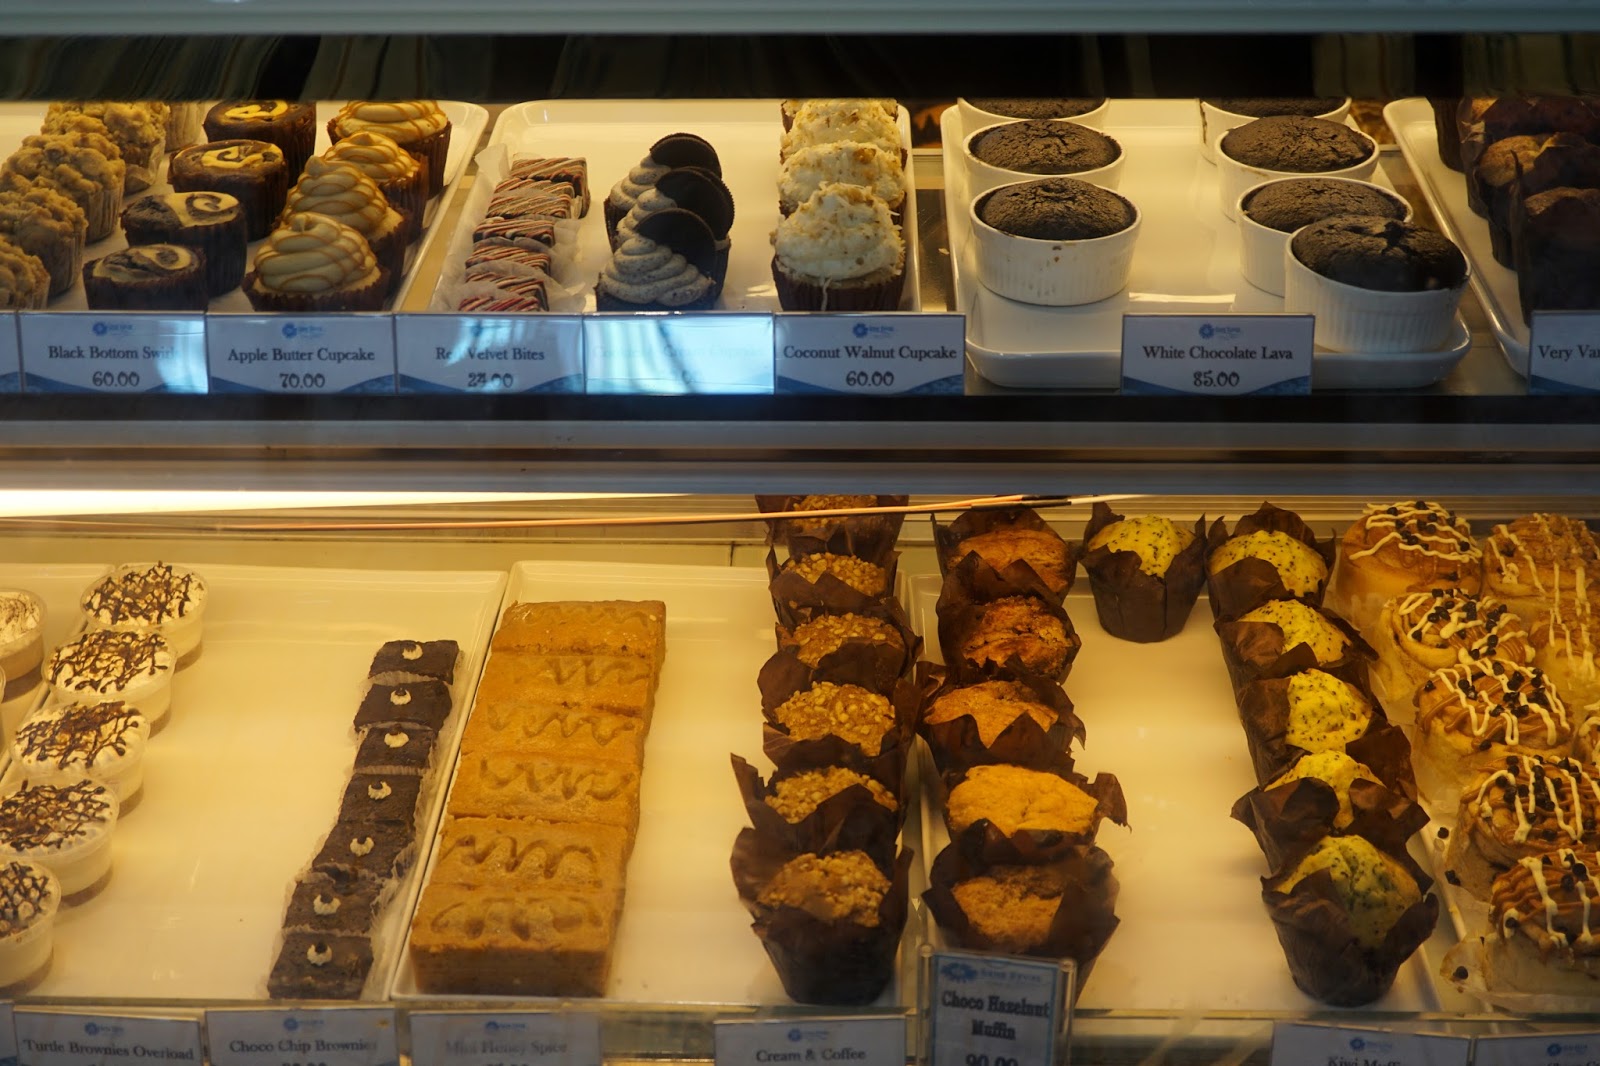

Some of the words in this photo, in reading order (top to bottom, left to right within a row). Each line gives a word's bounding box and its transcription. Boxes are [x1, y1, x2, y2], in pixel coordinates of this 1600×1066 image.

[48, 345, 85, 359] Black
[89, 346, 139, 359] Bottom
[228, 349, 268, 364] Apple
[272, 349, 313, 361] Butter
[317, 348, 375, 363] Cupcake
[435, 347, 458, 360] Re
[467, 347, 508, 360] Velvet
[512, 348, 545, 360] Bites
[783, 345, 840, 359] Coconut
[843, 345, 895, 359] Walnut
[899, 345, 957, 361] Cupcake
[1142, 346, 1185, 359] White
[1189, 346, 1257, 359] Chocolate
[1261, 346, 1293, 360] Lava
[1537, 345, 1573, 362] Very
[92, 370, 140, 387] 60.00
[279, 372, 326, 388] 70.00
[846, 370, 895, 387] 60.00
[1193, 370, 1240, 387] 85.00
[942, 990, 984, 1010] Choco
[988, 995, 1050, 1018] Hazelnut
[972, 1019, 1016, 1040] Muffin
[22, 1039, 64, 1053] Turtle
[70, 1041, 130, 1057] Brownies
[133, 1045, 194, 1061] Overload
[229, 1040, 274, 1053] Choco
[278, 1039, 311, 1054] Chip
[756, 1049, 800, 1063] Cream
[805, 1050, 815, 1062] &
[821, 1048, 867, 1061] Coffee
[966, 1054, 1018, 1066] 9000
